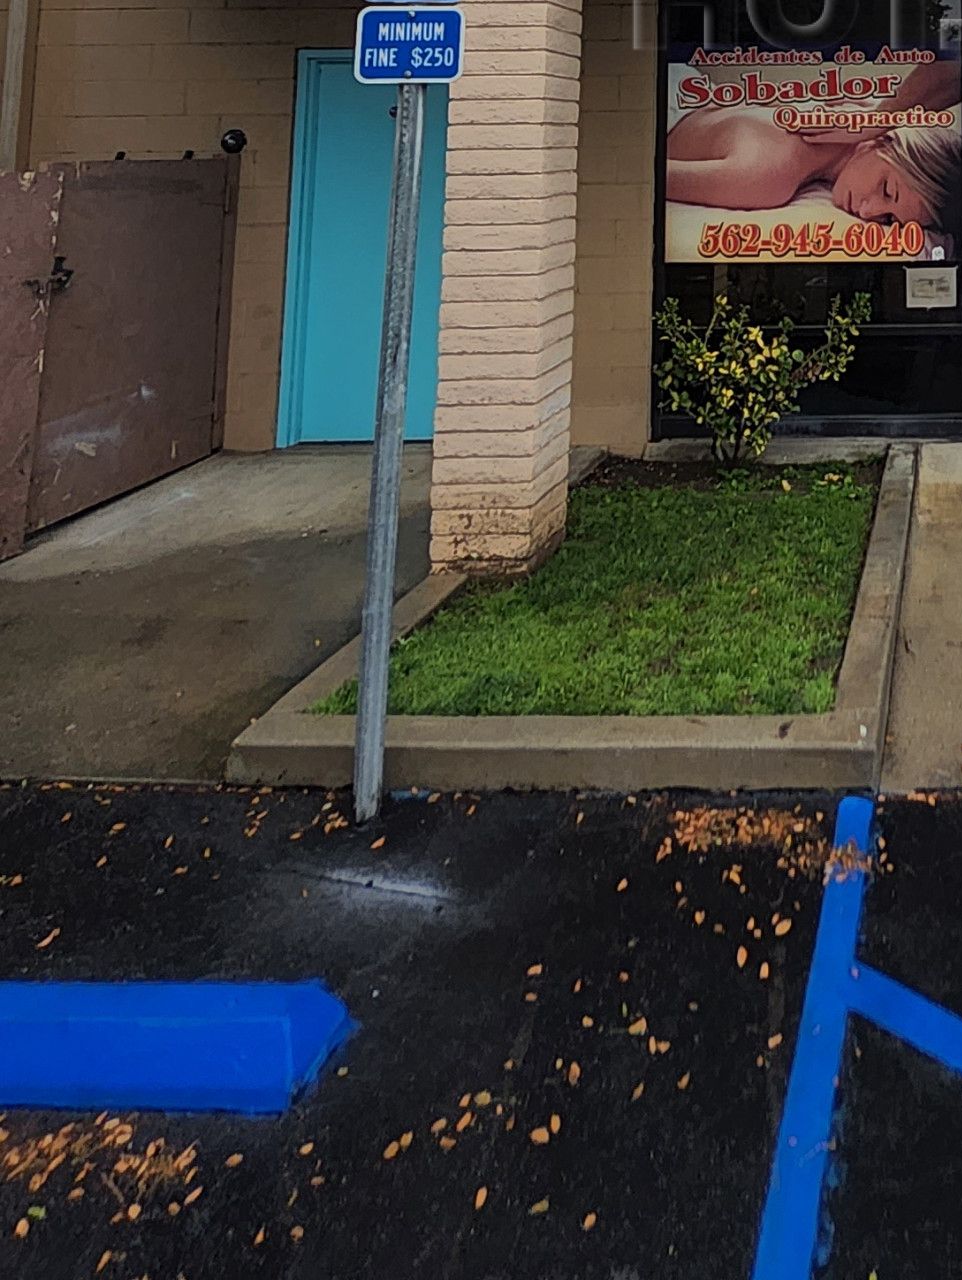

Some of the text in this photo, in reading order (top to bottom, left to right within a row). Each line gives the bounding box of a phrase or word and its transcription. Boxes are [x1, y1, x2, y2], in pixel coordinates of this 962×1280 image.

[378, 22, 445, 42] MINIMUM
[364, 47, 454, 68] FINE $250
[688, 46, 935, 65] Accidentes de Auto
[677, 68, 902, 109] Sobador
[774, 105, 954, 132] Quiropractico
[699, 221, 924, 258] 562-945-6040
